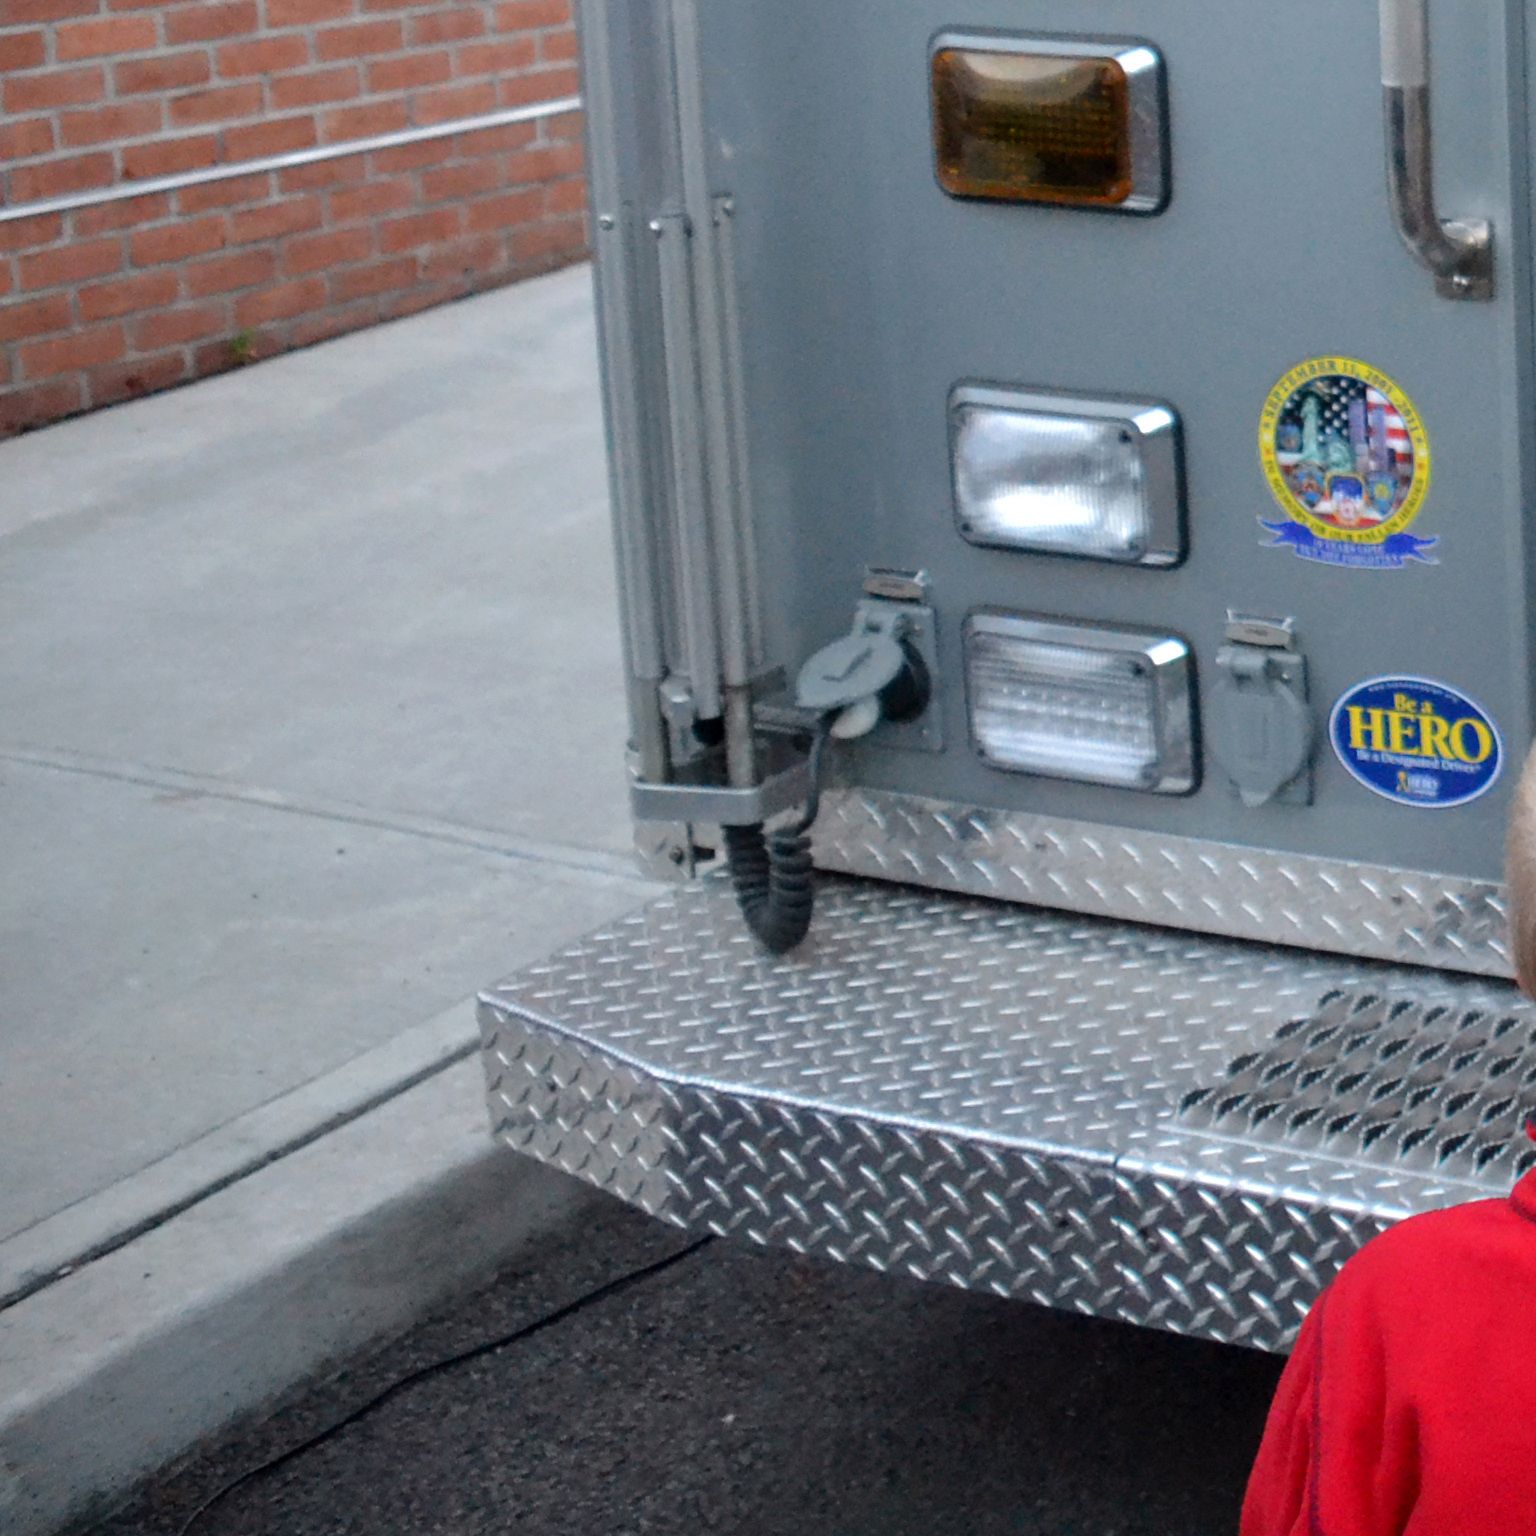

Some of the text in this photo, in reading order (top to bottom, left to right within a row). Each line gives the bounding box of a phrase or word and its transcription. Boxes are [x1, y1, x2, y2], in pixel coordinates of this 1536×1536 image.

[1265, 360, 1338, 418] SEPTEMBER
[1394, 693, 1434, 714] Be a
[1346, 705, 1493, 764] HERO
